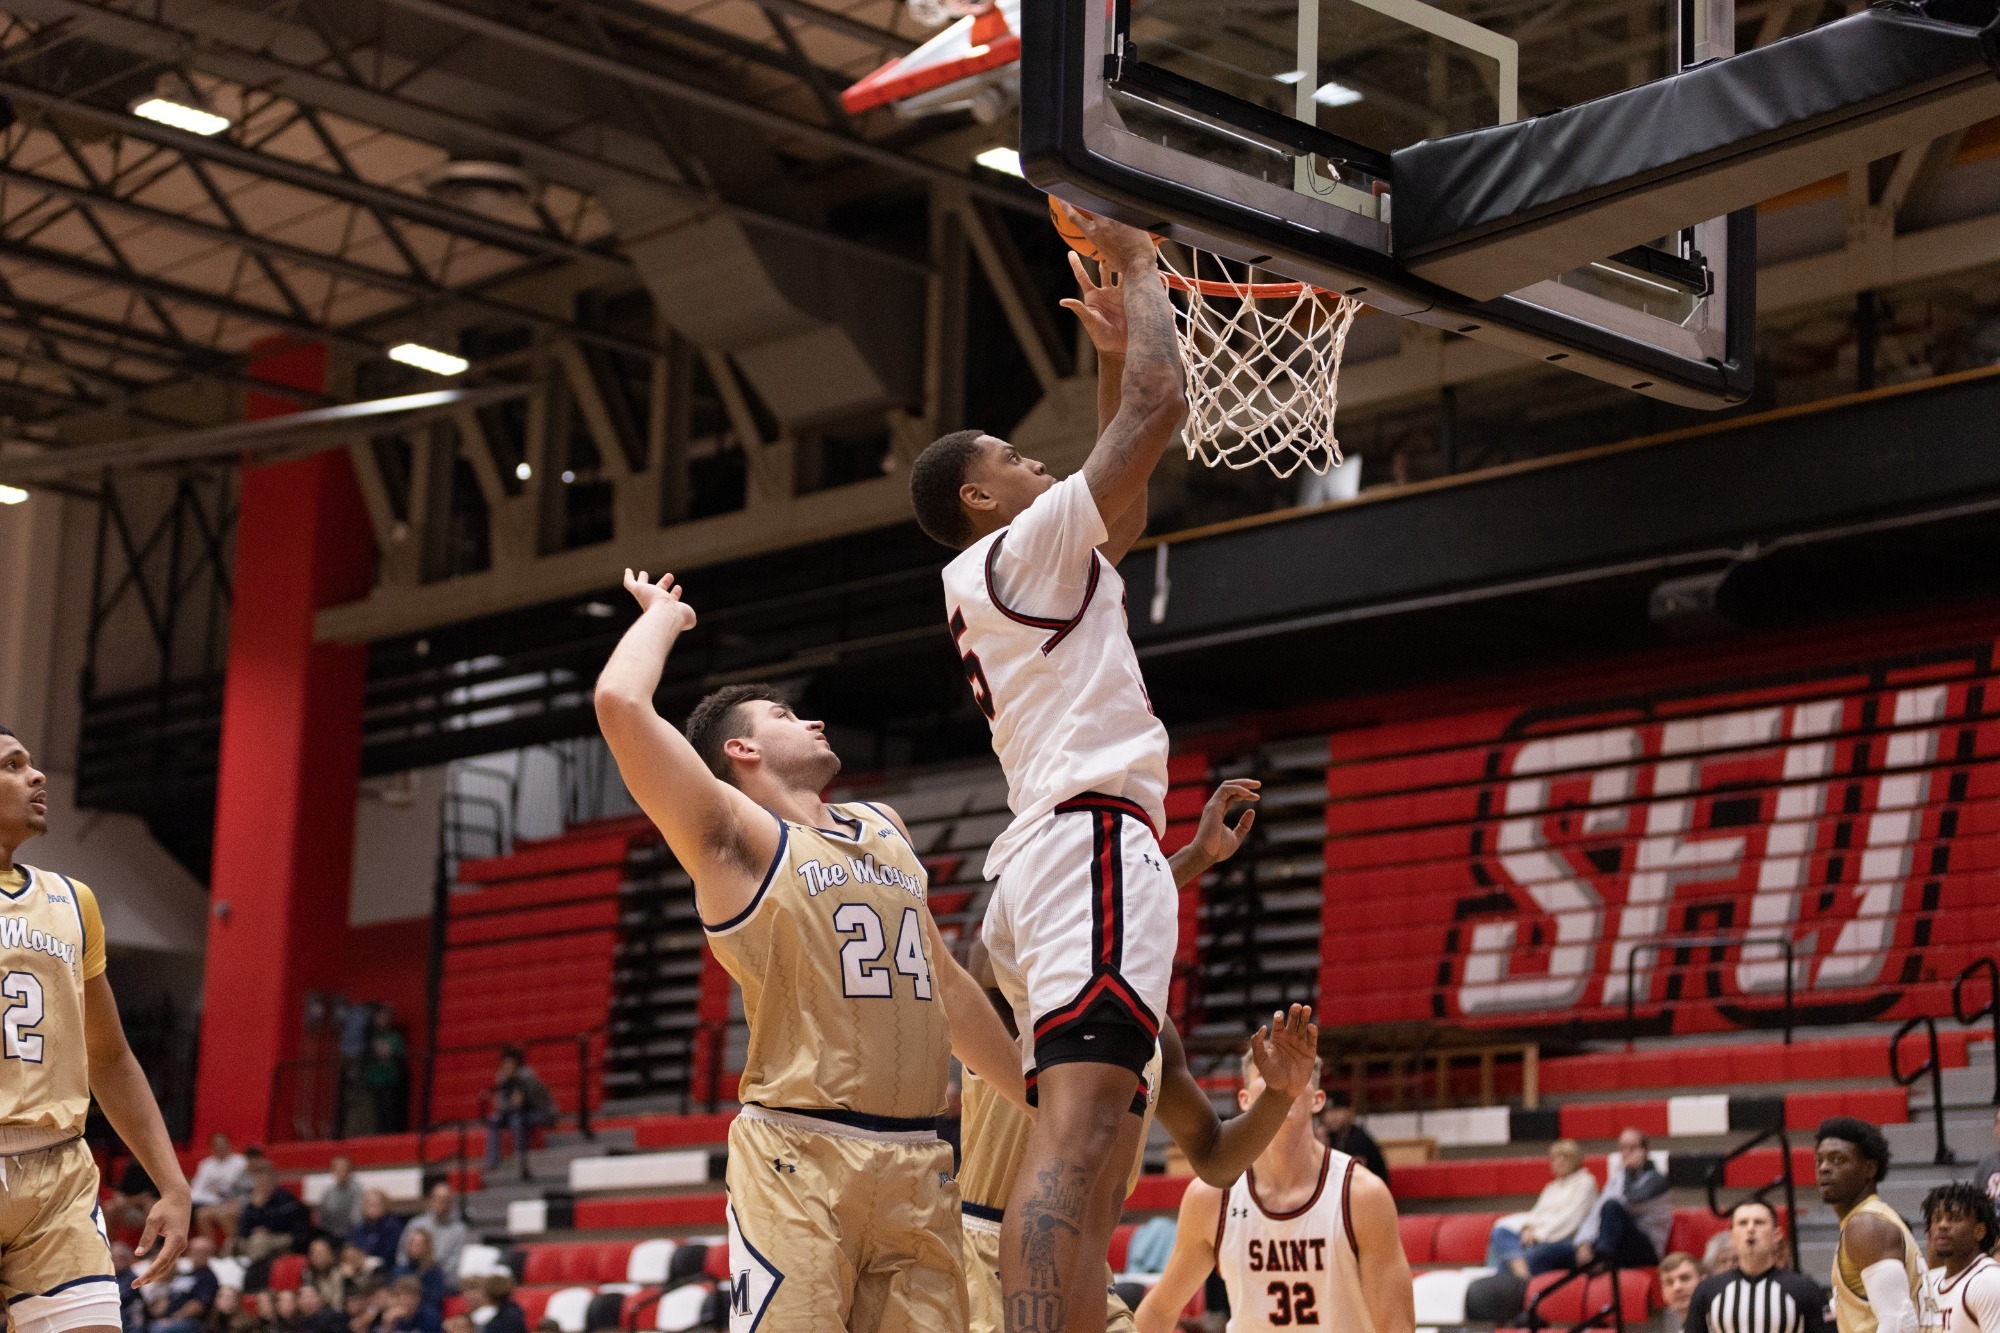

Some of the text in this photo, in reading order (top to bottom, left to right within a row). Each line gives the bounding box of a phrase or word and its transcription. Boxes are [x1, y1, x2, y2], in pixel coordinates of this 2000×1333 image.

[797, 853, 925, 906] The Mount
[1458, 684, 1949, 1016] SFU
[0, 915, 76, 977] Mount
[832, 903, 932, 1001] 24
[1, 971, 45, 1064] 2
[1248, 1238, 1325, 1272] SAINT
[1267, 1281, 1320, 1326] 32
